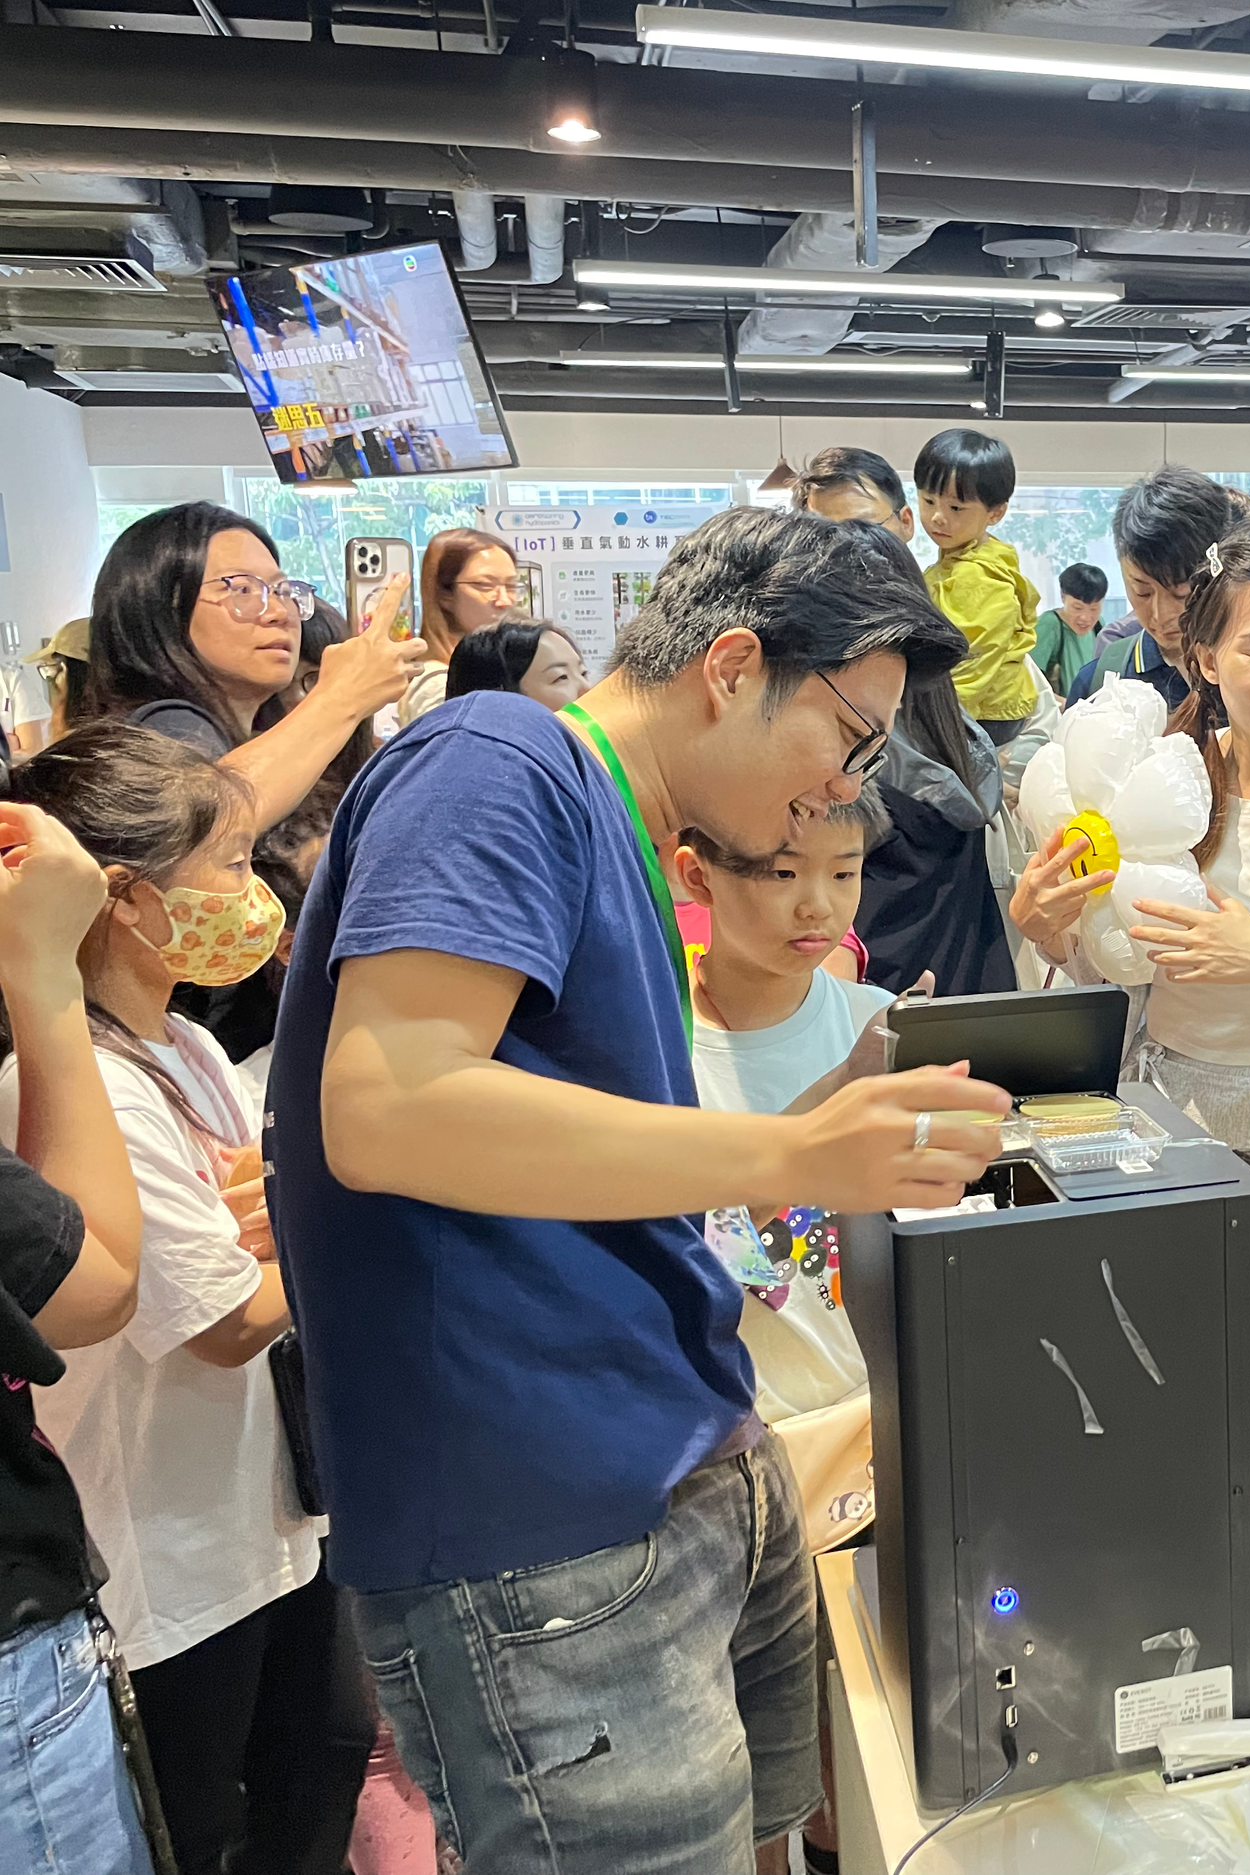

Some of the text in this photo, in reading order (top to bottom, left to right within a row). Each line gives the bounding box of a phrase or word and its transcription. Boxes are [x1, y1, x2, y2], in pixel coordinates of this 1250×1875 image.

[270, 402, 325, 431] 迷思五
[562, 535, 684, 551] 垂直氣動水耕
